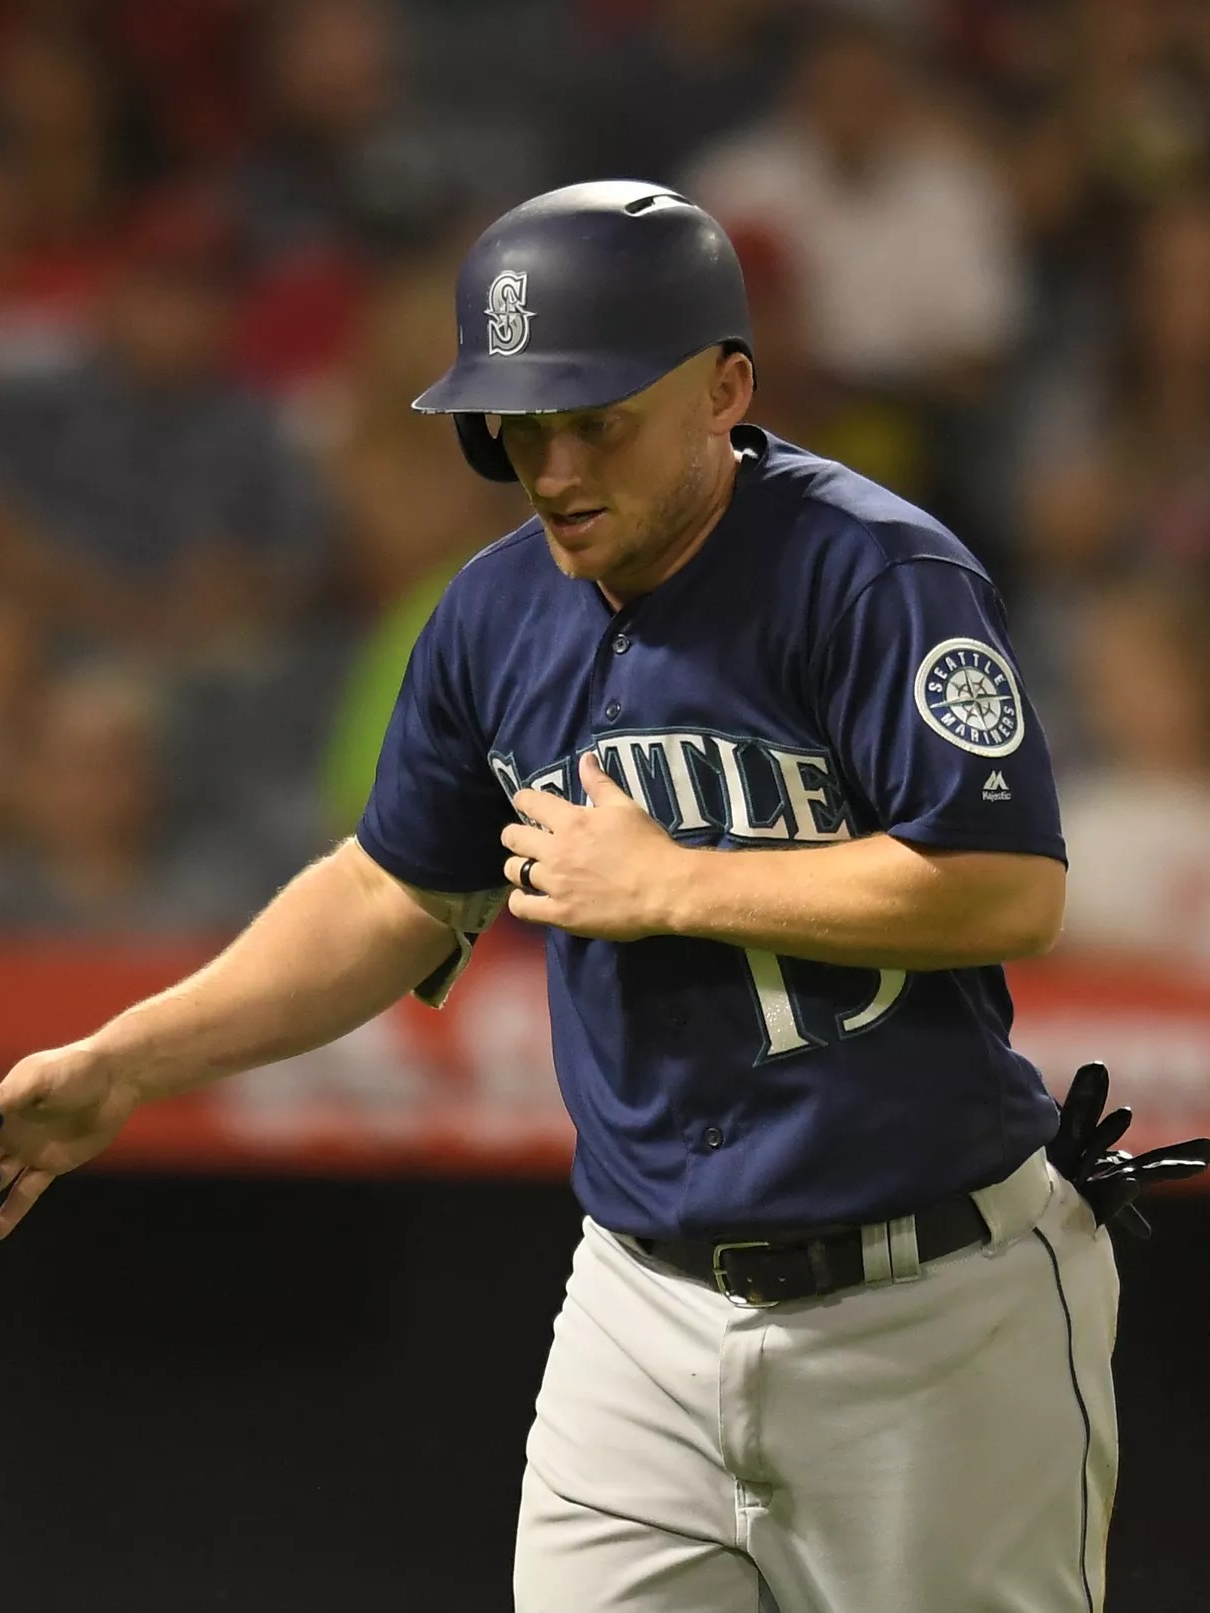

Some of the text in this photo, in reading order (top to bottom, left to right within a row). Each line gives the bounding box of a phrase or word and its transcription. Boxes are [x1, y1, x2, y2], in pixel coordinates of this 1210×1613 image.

[928, 651, 1007, 693] SEATTLE
[940, 705, 1015, 745] MARINERS
[490, 729, 856, 843] TTLE
